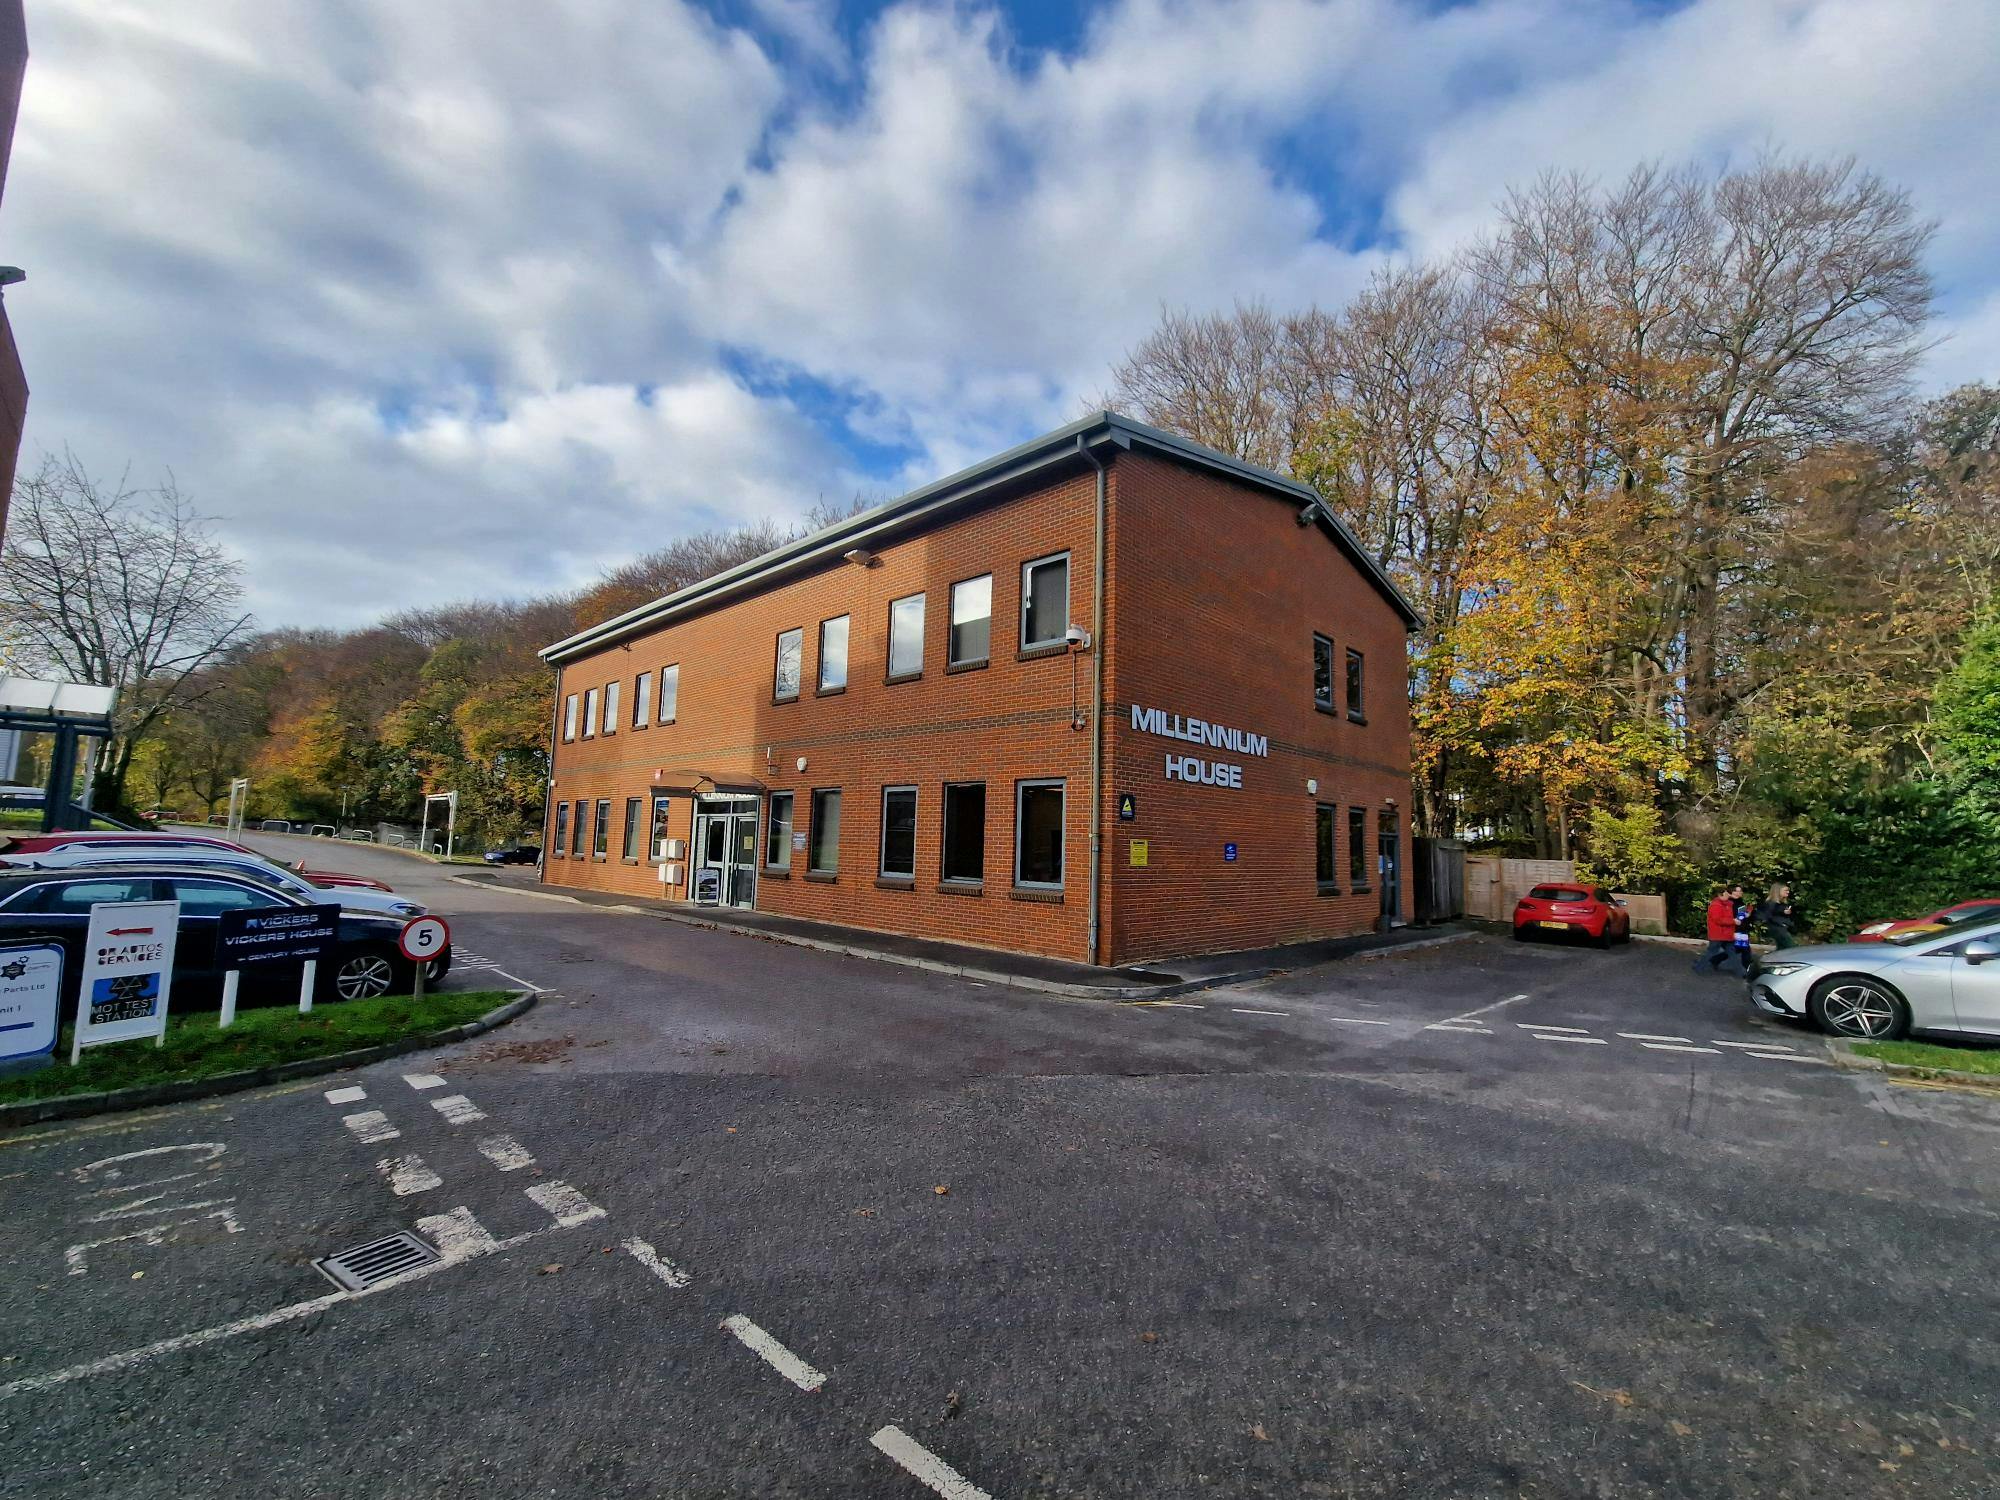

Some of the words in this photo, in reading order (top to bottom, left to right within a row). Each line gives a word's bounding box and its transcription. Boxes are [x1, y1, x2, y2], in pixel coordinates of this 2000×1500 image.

[1131, 704, 1268, 758] MILLENNIUM
[1165, 754, 1243, 789] HOUSE
[259, 914, 319, 926] VICKERS
[225, 932, 286, 945] VICKERS
[289, 928, 334, 939] HOUSE
[418, 929, 432, 947] 5
[121, 942, 164, 955] AUTOS
[97, 951, 163, 966] SERVICES
[3, 986, 29, 994] Parts
[31, 983, 45, 991] Ltd
[91, 1002, 120, 1015] MOT
[125, 997, 157, 1009] TEST
[95, 1008, 152, 1023] STATION
